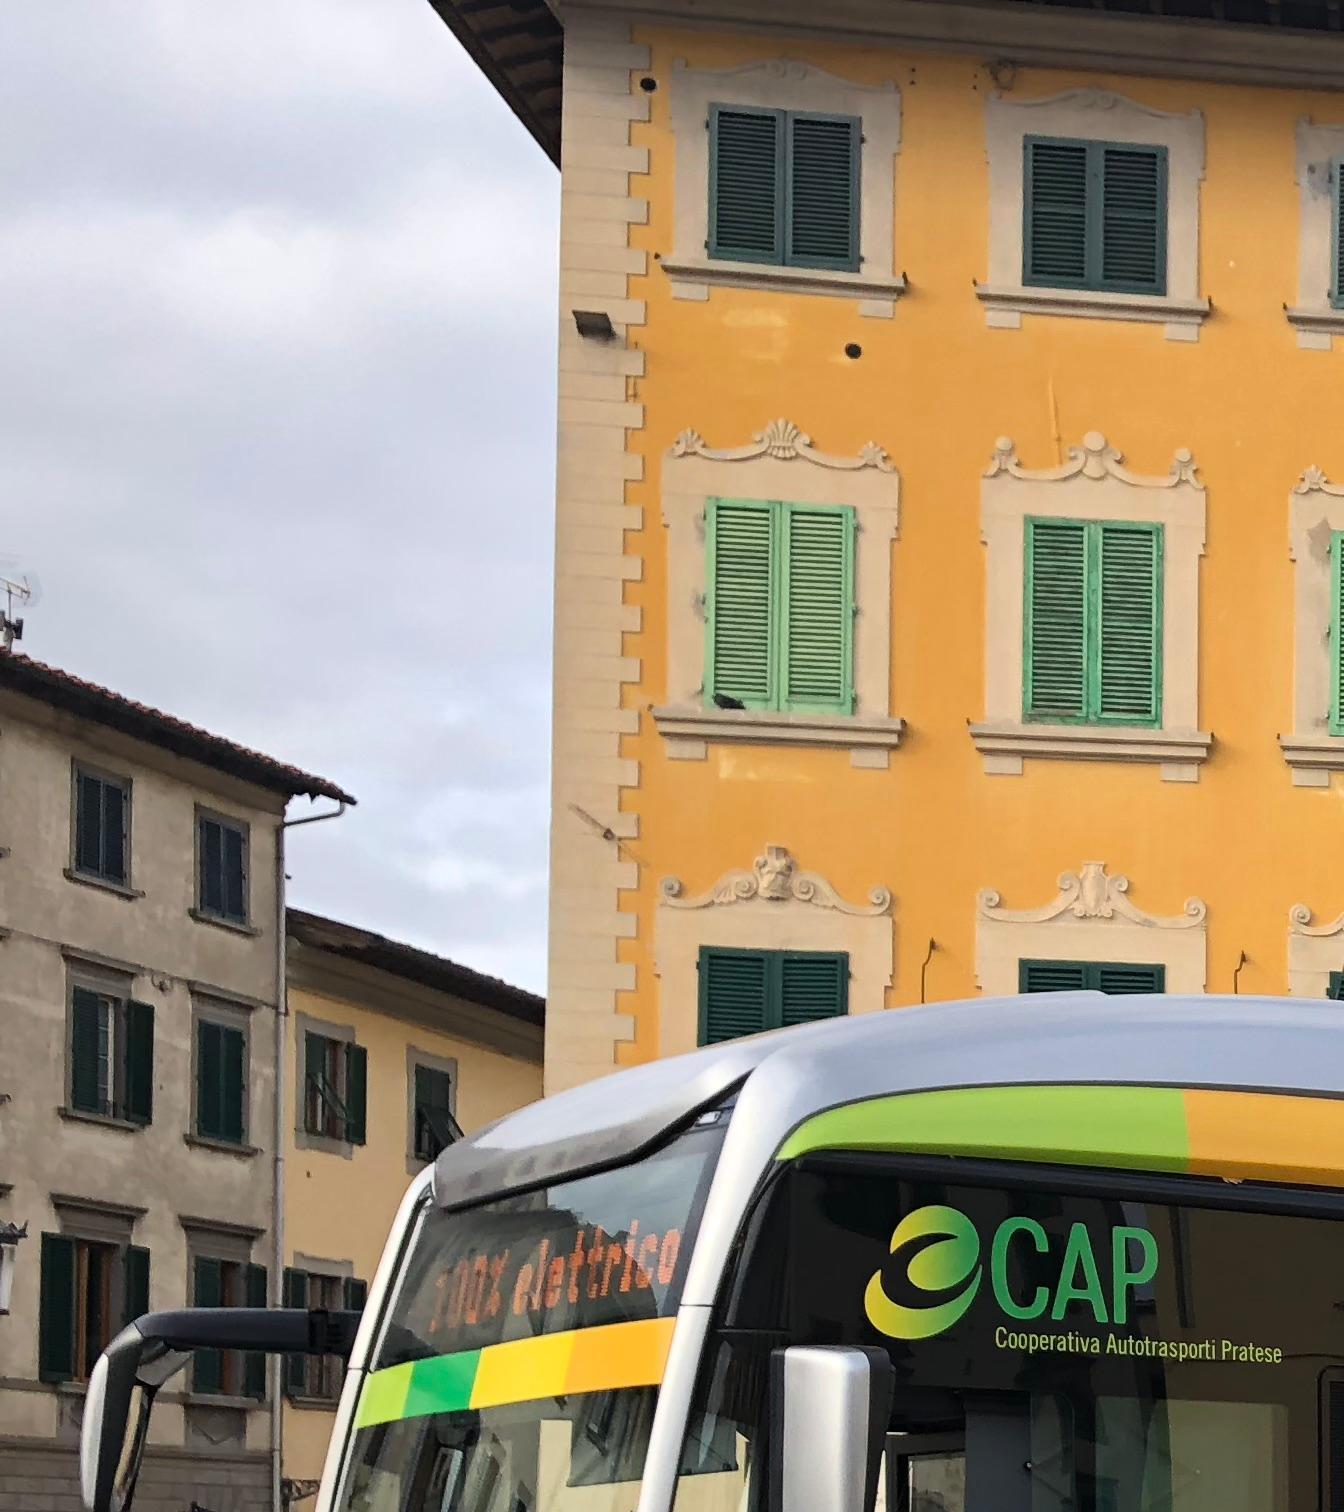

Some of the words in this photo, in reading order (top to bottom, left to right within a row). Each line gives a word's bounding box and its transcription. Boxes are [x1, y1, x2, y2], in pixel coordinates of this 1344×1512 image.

[512, 1219, 681, 1316] elettrico
[991, 1216, 1159, 1324] CAP
[995, 1326, 1100, 1354] Cooperativa
[1106, 1333, 1216, 1361] Autotrasporti
[1222, 1340, 1283, 1364] Pratese
